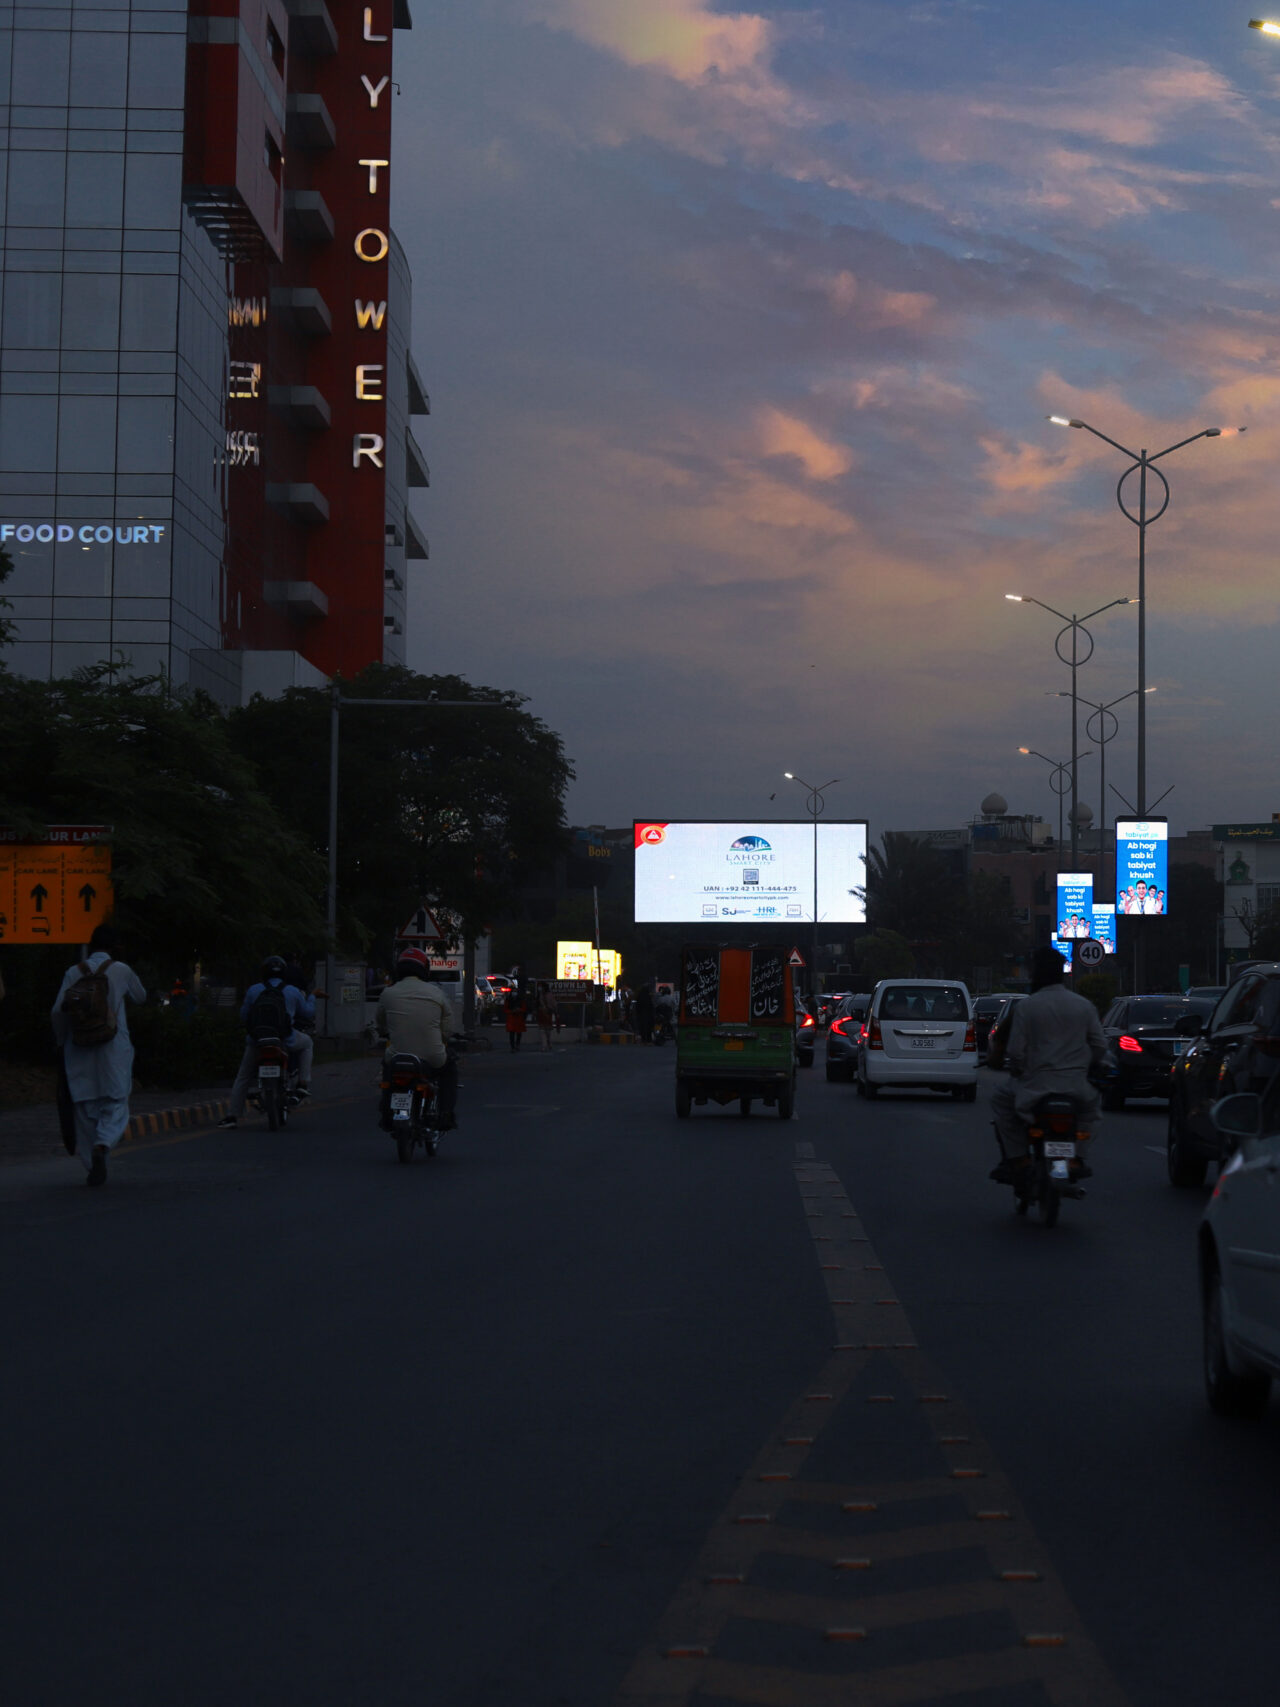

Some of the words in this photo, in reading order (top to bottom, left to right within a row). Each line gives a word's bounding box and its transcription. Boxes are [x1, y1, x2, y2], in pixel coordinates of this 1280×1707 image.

[352, 159, 389, 469] TOWER
[1, 524, 75, 543] FOOD
[78, 525, 165, 544] COURT
[1139, 841, 1157, 852] hogi
[725, 853, 776, 862] LAHORE
[1130, 851, 1145, 859] sab
[1146, 851, 1154, 859] ki
[1127, 861, 1157, 871] tabiyat
[1129, 871, 1154, 879] khush
[1082, 945, 1100, 960] 40
[430, 958, 458, 968] hange
